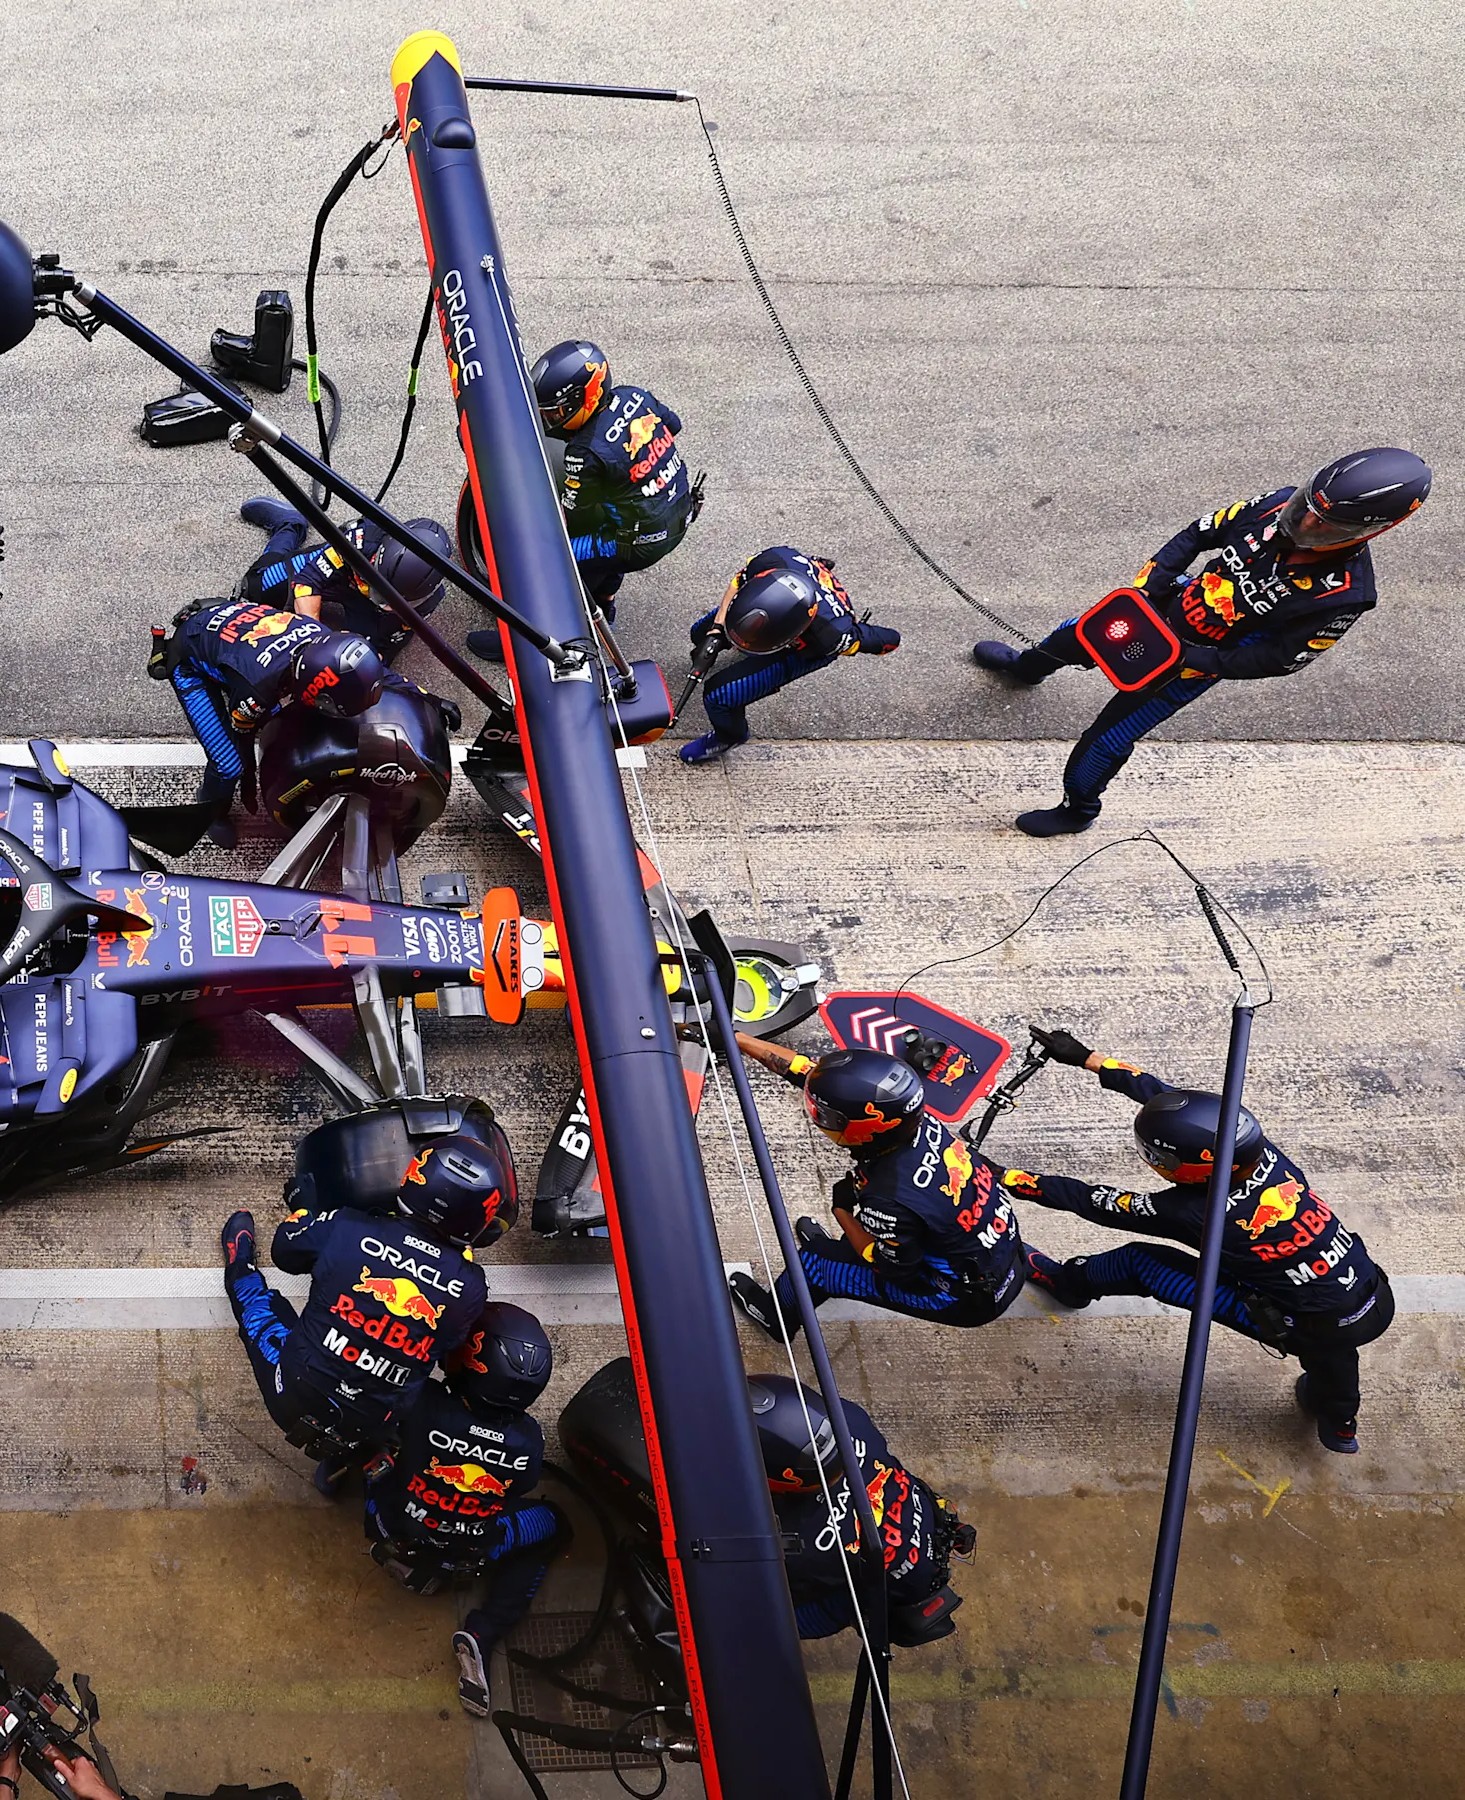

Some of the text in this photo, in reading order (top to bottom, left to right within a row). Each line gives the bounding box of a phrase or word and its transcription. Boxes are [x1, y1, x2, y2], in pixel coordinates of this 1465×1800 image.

[443, 269, 483, 386] ORACLE
[605, 392, 644, 442] ORACLE
[629, 444, 657, 482] Red
[316, 555, 333, 578] VISA
[1221, 545, 1273, 616] ORACLE
[1185, 603, 1230, 641] Bull
[257, 623, 321, 668] ORACLE
[483, 728, 522, 745] Cla
[360, 767, 390, 779] Hard
[33, 802, 43, 831] PEPE
[42, 885, 50, 908] TAG
[2, 926, 31, 966] telcel
[177, 887, 193, 967] ORACLE
[214, 901, 231, 952] TAG
[237, 900, 259, 953] HEUER
[401, 917, 421, 959] VISA
[446, 919, 463, 964] zoom
[460, 921, 471, 949] ARCTIC
[468, 924, 479, 946] WOLF
[97, 931, 119, 967] Bull
[509, 919, 518, 993] BRAKES
[141, 985, 232, 1005] BYBIT
[35, 994, 48, 1072] PEPE JEANS
[403, 1235, 441, 1258] sparco
[1250, 1221, 1315, 1262] Red
[1285, 1236, 1347, 1285] Mobil
[360, 1237, 464, 1298] ORACLE
[329, 1294, 434, 1362] Red Bull
[323, 1328, 390, 1378] Mobil
[469, 1425, 505, 1443] sparco
[629, 1327, 669, 1528] REDBULLRACING.COM
[429, 1430, 530, 1471] ORACLE
[407, 1474, 460, 1512] Red
[405, 1501, 466, 1535] Mobil
[671, 1567, 711, 1759] @REDBULLRACING
